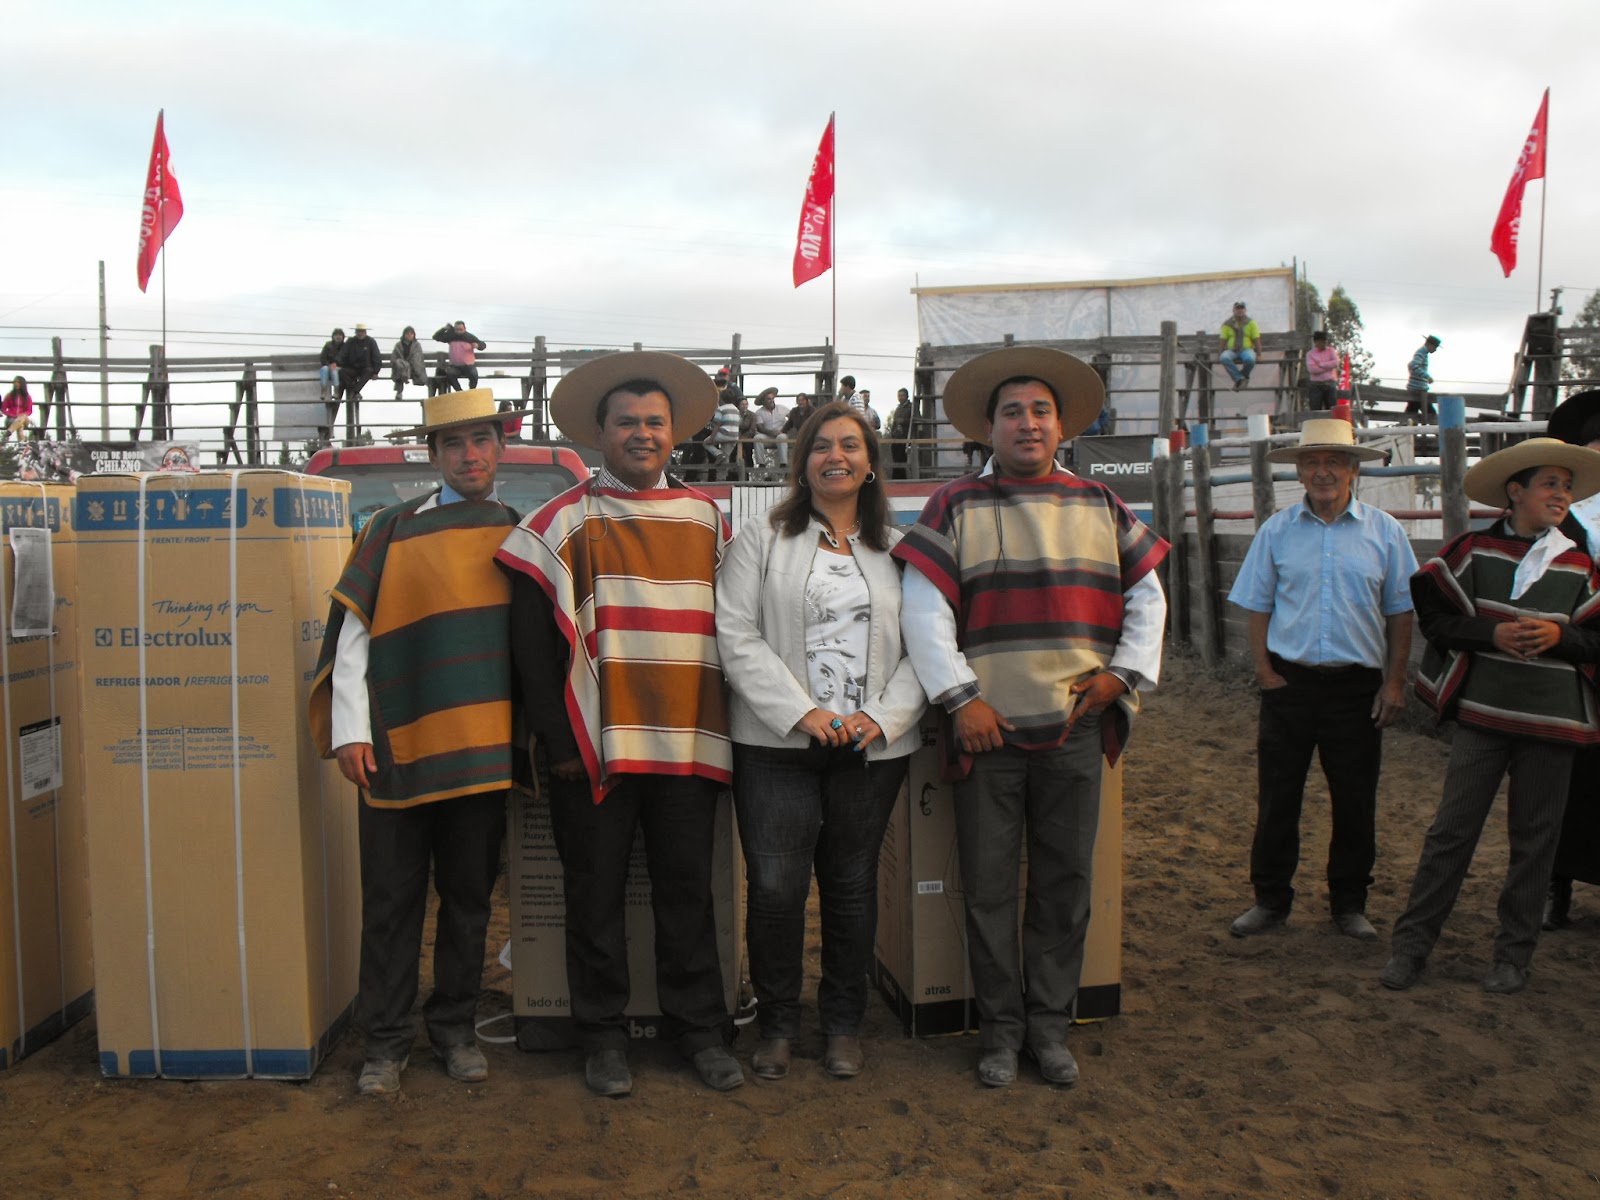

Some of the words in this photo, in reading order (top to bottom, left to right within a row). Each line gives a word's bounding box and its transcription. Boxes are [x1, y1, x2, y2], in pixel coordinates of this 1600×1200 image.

[91, 451, 109, 460] CLUB
[112, 451, 121, 460] DE
[123, 451, 145, 460] RODEO
[96, 459, 141, 472] CHILENO
[152, 600, 213, 624] Thinking
[217, 600, 230, 615] of
[236, 603, 273, 618] you
[120, 627, 233, 646] Electrolux
[95, 677, 181, 687] REFRIGERADOR
[137, 727, 181, 736] Aención
[187, 727, 229, 735] Attention
[924, 984, 951, 996] atras
[527, 996, 552, 1008] lado
[554, 996, 569, 1008] de
[630, 1019, 657, 1039] be
